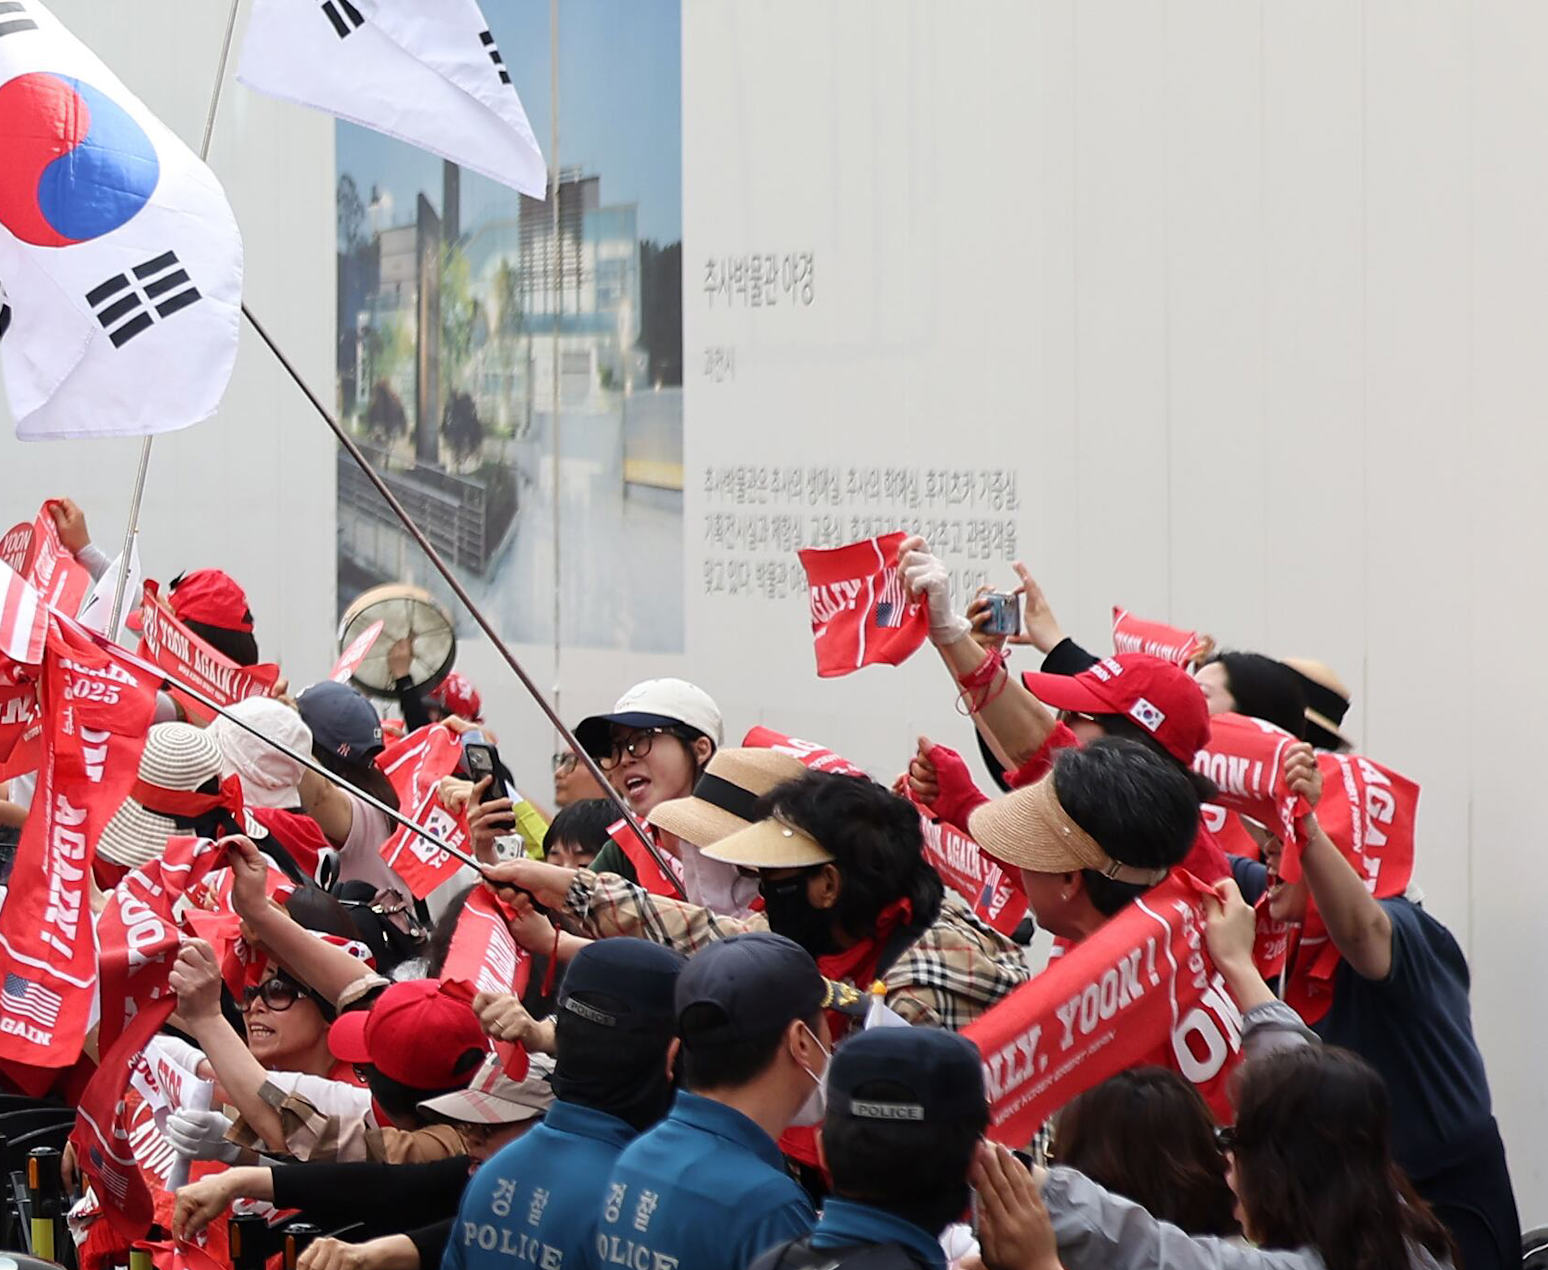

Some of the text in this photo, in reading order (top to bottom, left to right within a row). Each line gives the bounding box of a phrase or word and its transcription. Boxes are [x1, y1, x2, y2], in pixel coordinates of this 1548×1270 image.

[704, 252, 813, 308] 추사박물관 야경
[39, 792, 90, 960] AGAIN!
[1055, 936, 1160, 1052] YOON!
[857, 1104, 919, 1120] POLICE
